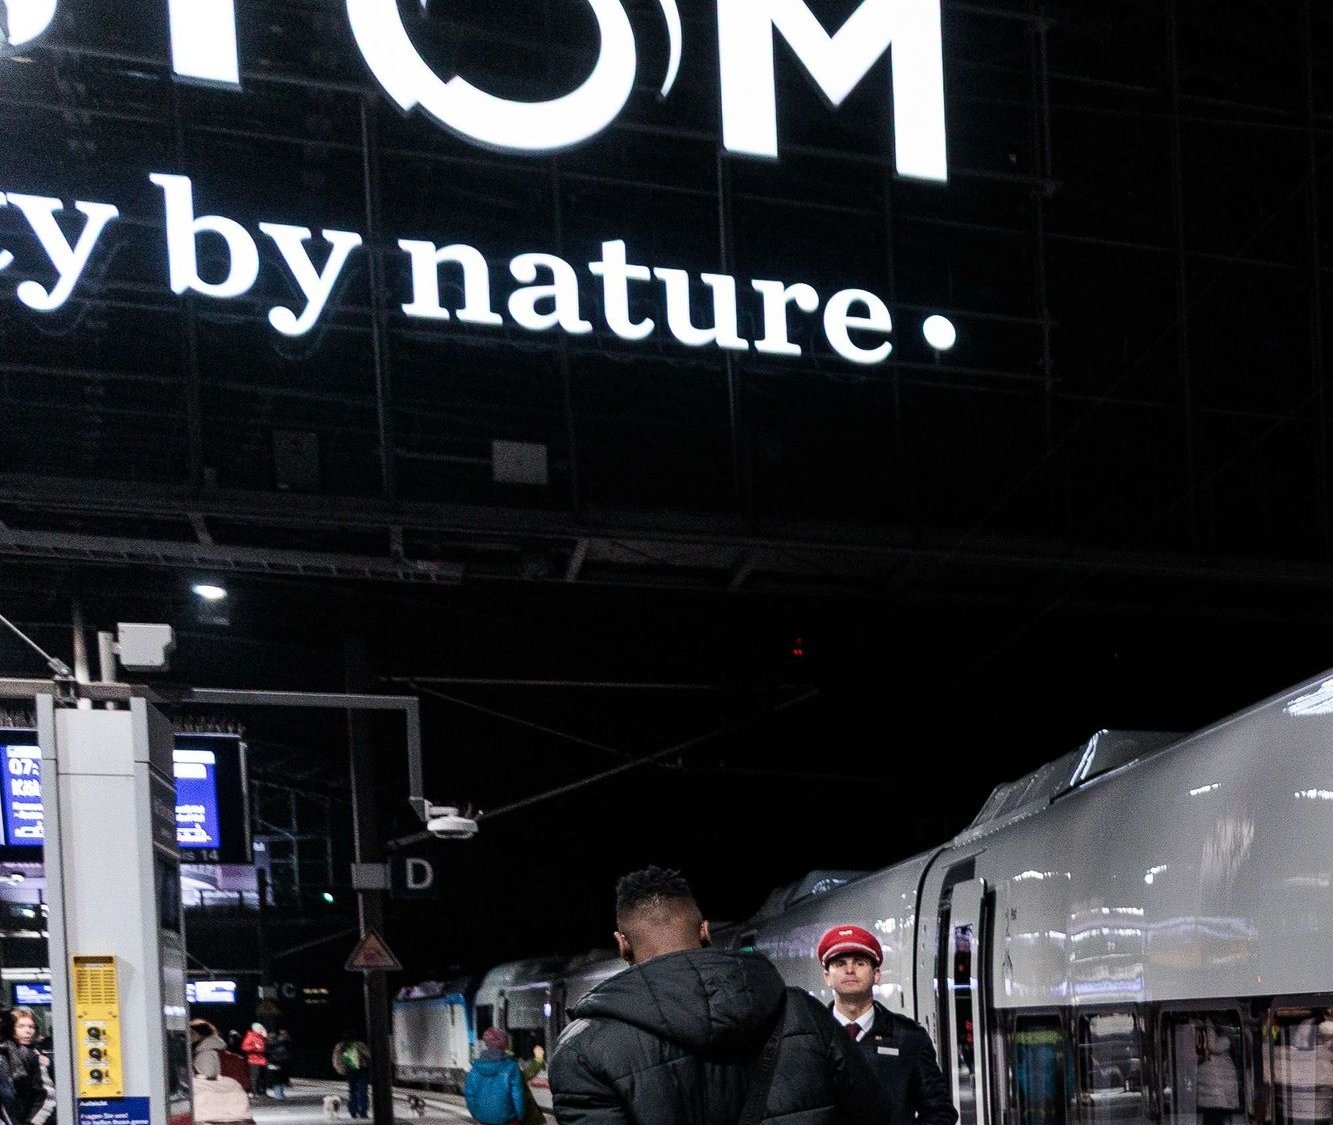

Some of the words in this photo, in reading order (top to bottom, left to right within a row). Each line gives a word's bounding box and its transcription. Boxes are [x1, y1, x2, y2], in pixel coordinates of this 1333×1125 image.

[0, 192, 119, 311] y
[150, 173, 361, 338] by
[406, 857, 434, 890] D
